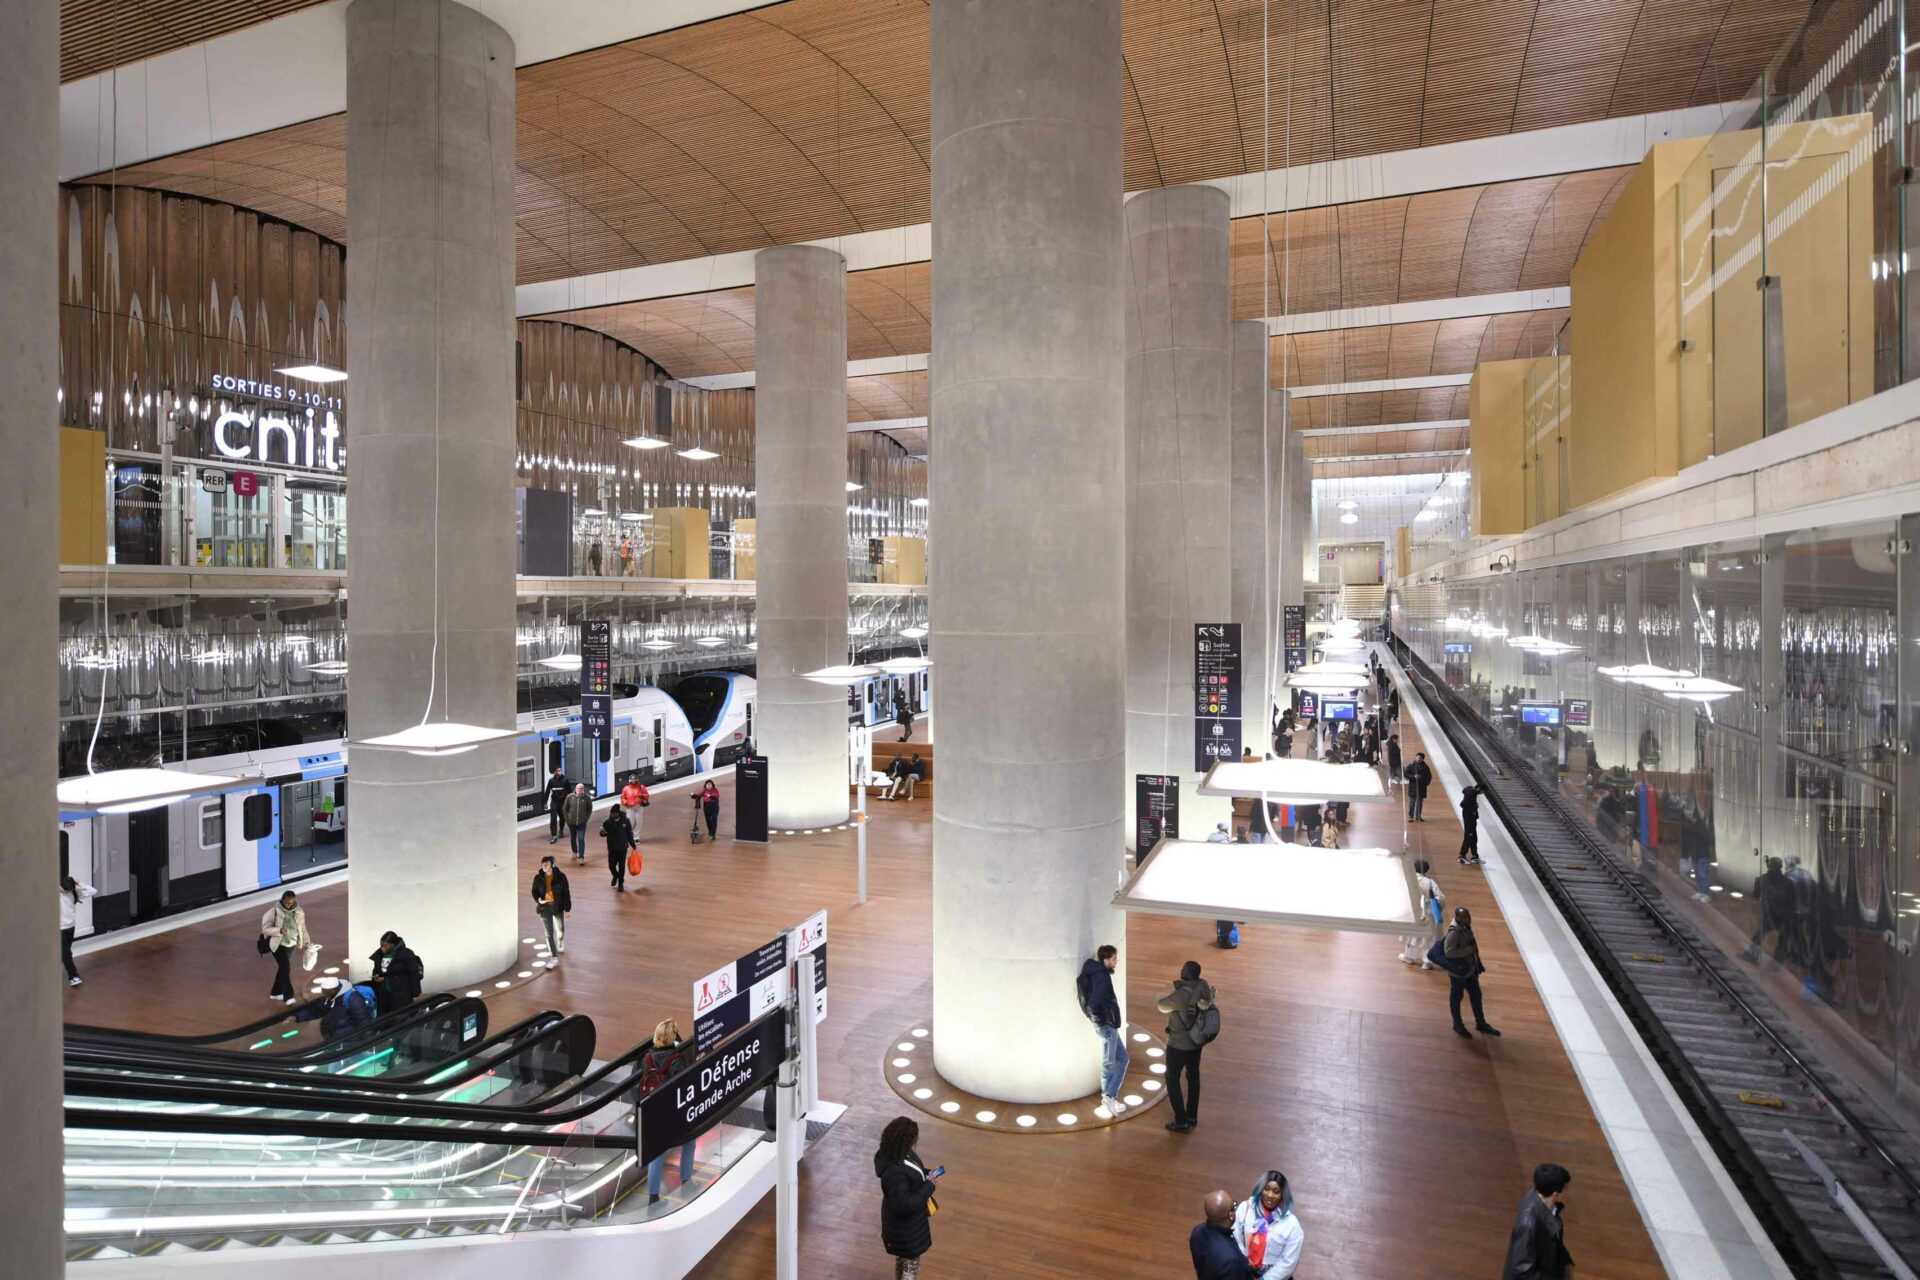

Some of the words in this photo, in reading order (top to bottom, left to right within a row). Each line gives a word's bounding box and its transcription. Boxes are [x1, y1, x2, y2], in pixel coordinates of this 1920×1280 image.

[212, 374, 281, 399] SORTIES
[288, 389, 341, 410] 9-10-11
[214, 407, 340, 470] cnit
[205, 475, 224, 486] RER
[240, 477, 250, 491] E
[1221, 704, 1227, 712] P
[698, 1018, 715, 1032] Utilisez
[705, 1021, 724, 1037] escaliers.
[677, 1084, 695, 1109] La
[701, 1039, 760, 1092] Défense
[686, 1089, 723, 1122] Grande
[725, 1067, 752, 1096] Arche
